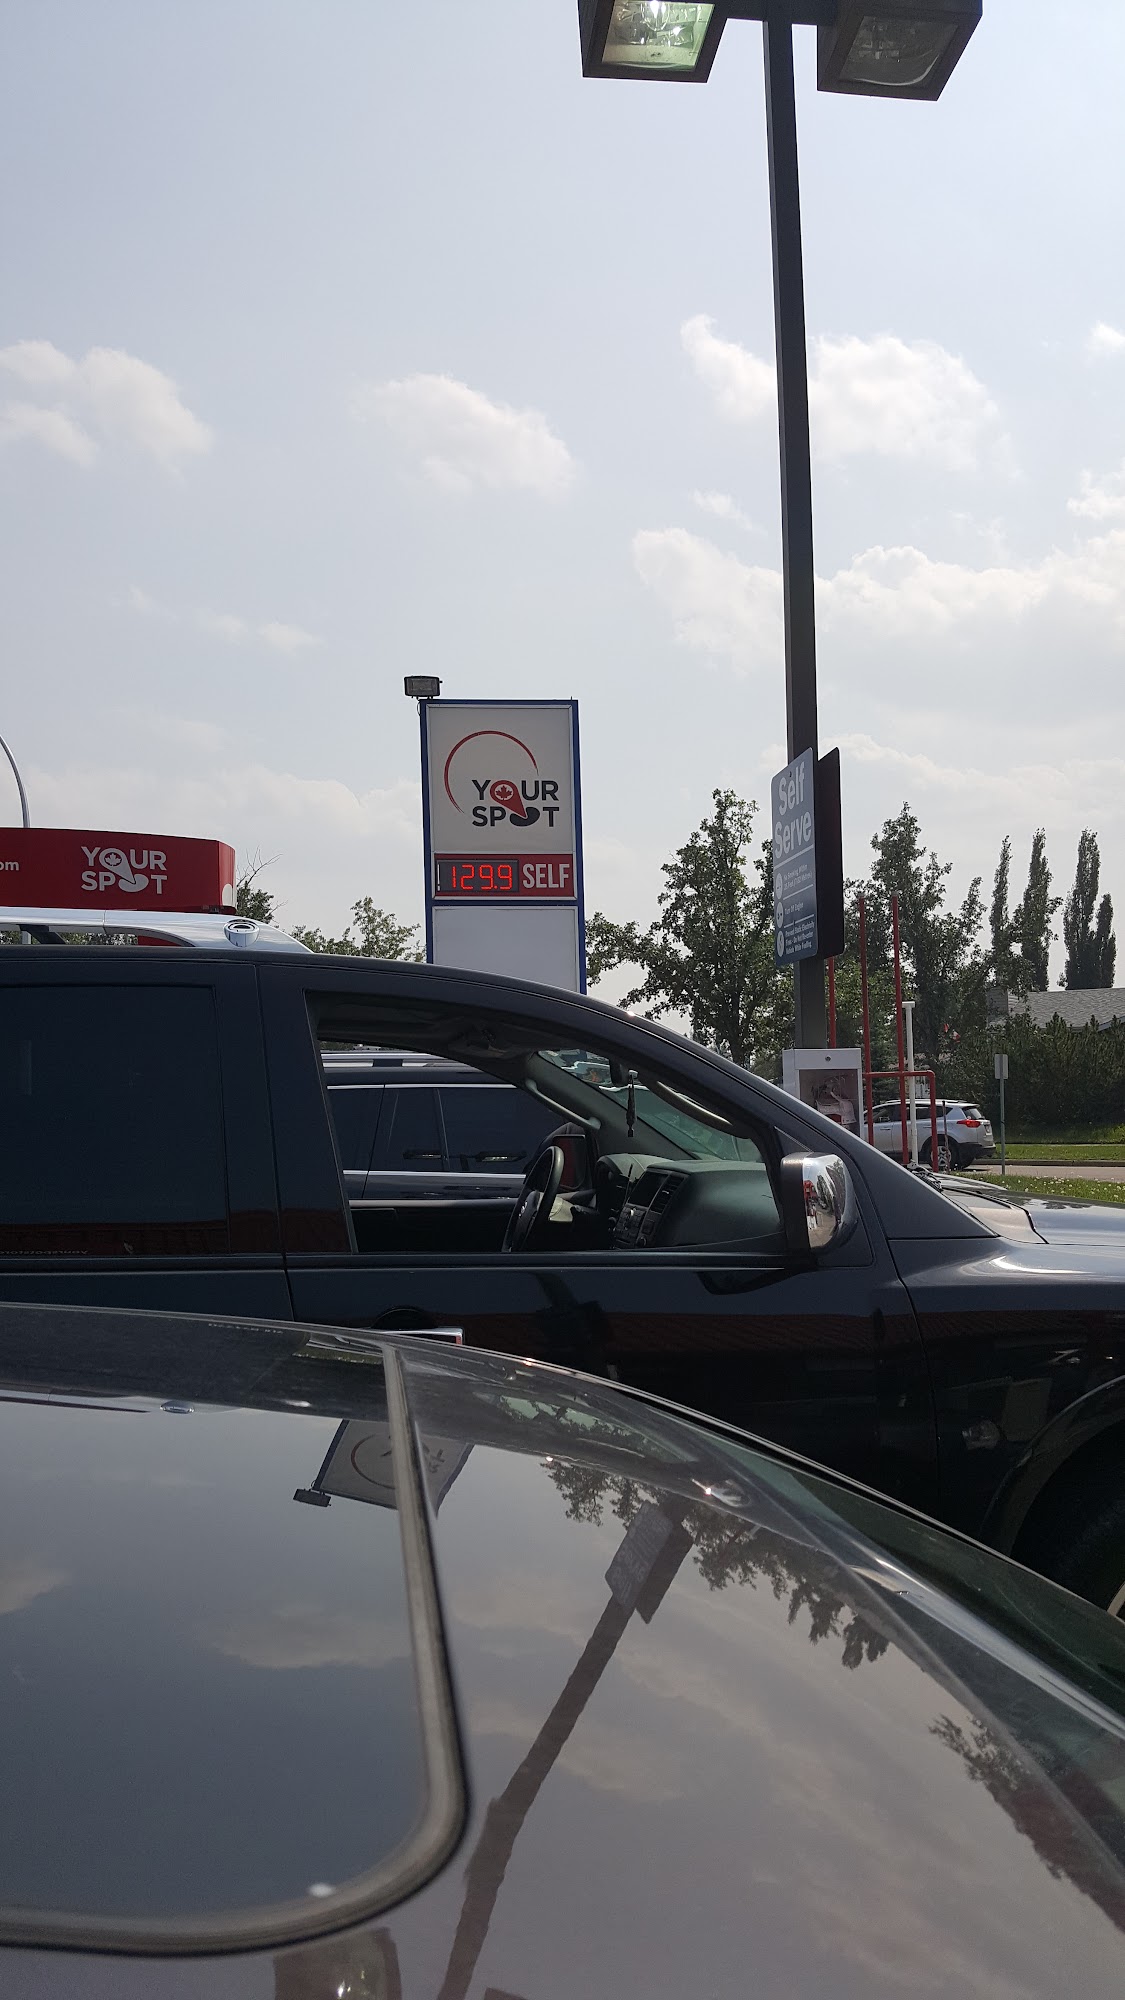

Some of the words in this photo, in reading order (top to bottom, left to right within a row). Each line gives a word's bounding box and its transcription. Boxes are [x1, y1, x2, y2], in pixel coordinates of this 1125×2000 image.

[471, 779, 559, 801] YOUR
[778, 761, 805, 816] Self
[472, 806, 560, 827] SPOT
[774, 811, 812, 859] Serve
[81, 846, 167, 871] YOUR
[81, 871, 168, 895] SPOT
[522, 863, 570, 889] SELF
